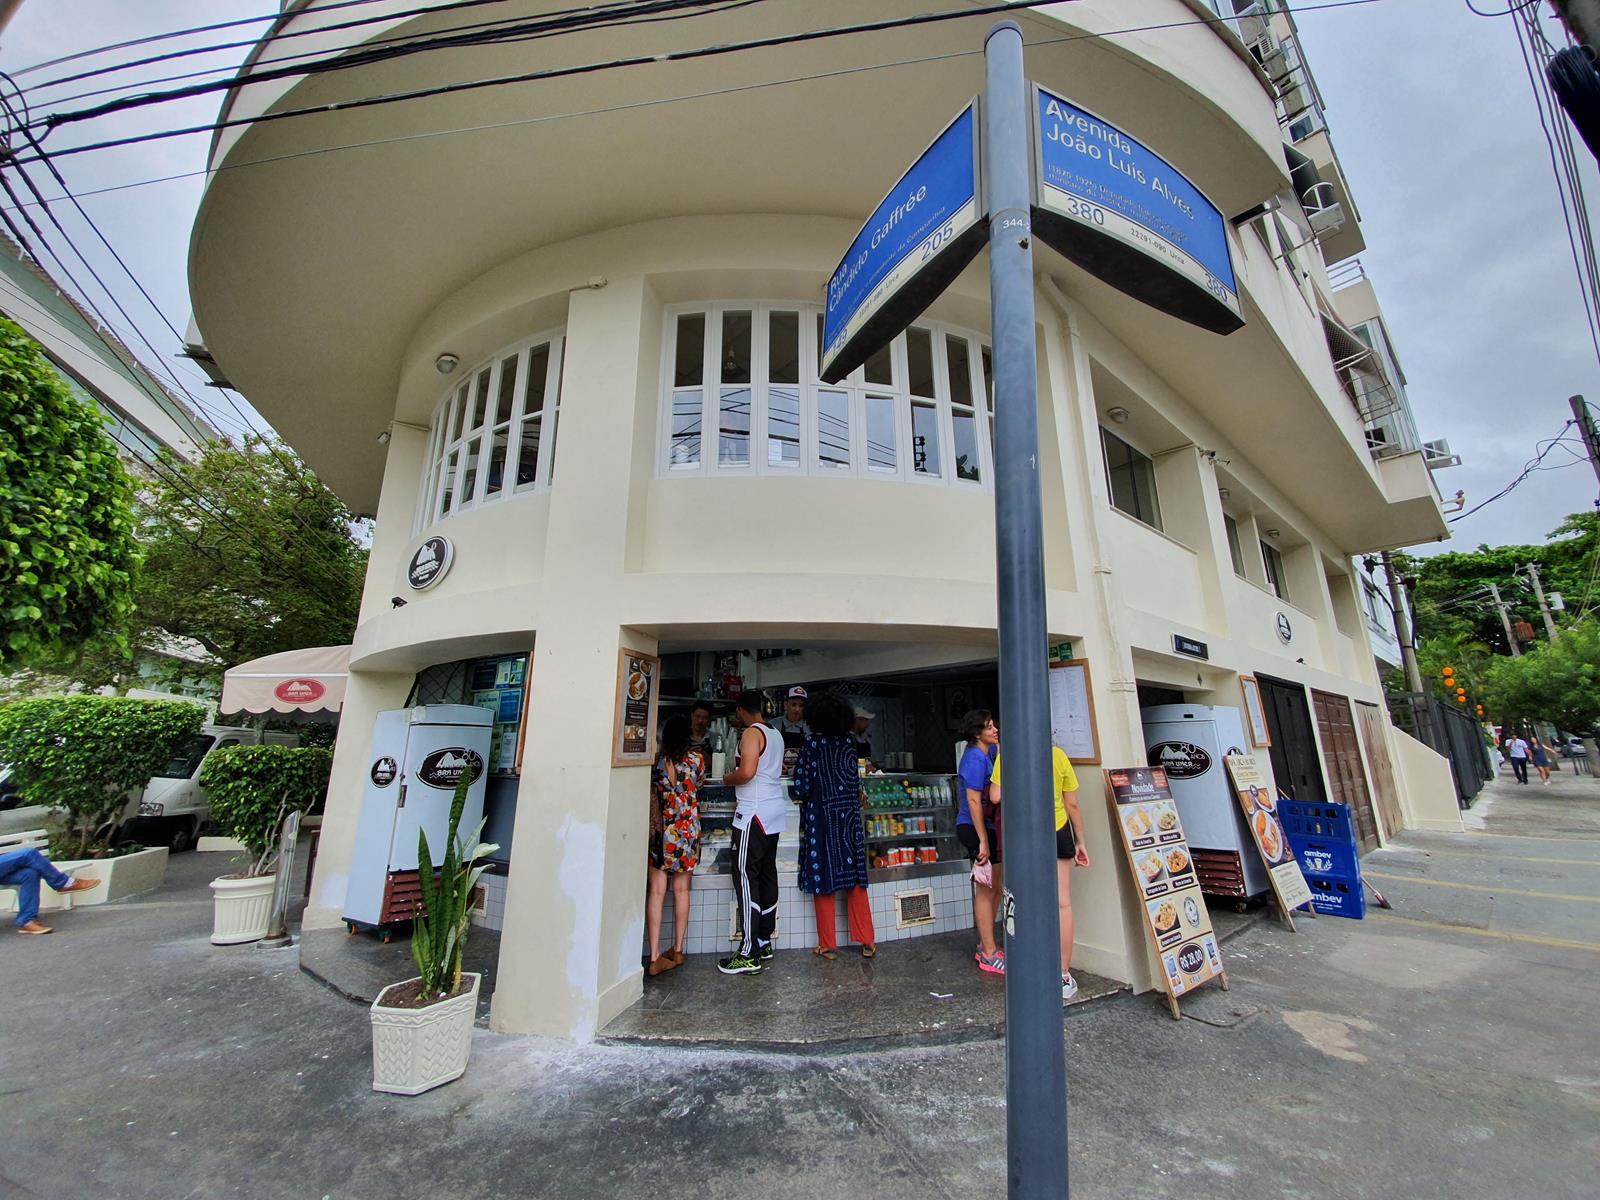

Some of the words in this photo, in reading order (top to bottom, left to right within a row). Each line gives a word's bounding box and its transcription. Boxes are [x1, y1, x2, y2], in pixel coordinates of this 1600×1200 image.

[1046, 99, 1131, 155] Avenida
[1047, 123, 1102, 160] João
[1108, 148, 1146, 185] Luís
[1152, 176, 1194, 220] Alves
[871, 184, 926, 249] Gaffrée
[1067, 197, 1104, 226] 380
[921, 221, 953, 262] 205
[830, 263, 847, 295] Rua
[1205, 272, 1228, 302] 380
[1180, 743, 1196, 754] 80
[1131, 783, 1155, 793] Novidade
[1304, 850, 1331, 858] ambev
[1180, 955, 1190, 969] R$
[1187, 949, 1203, 966] 28,00
